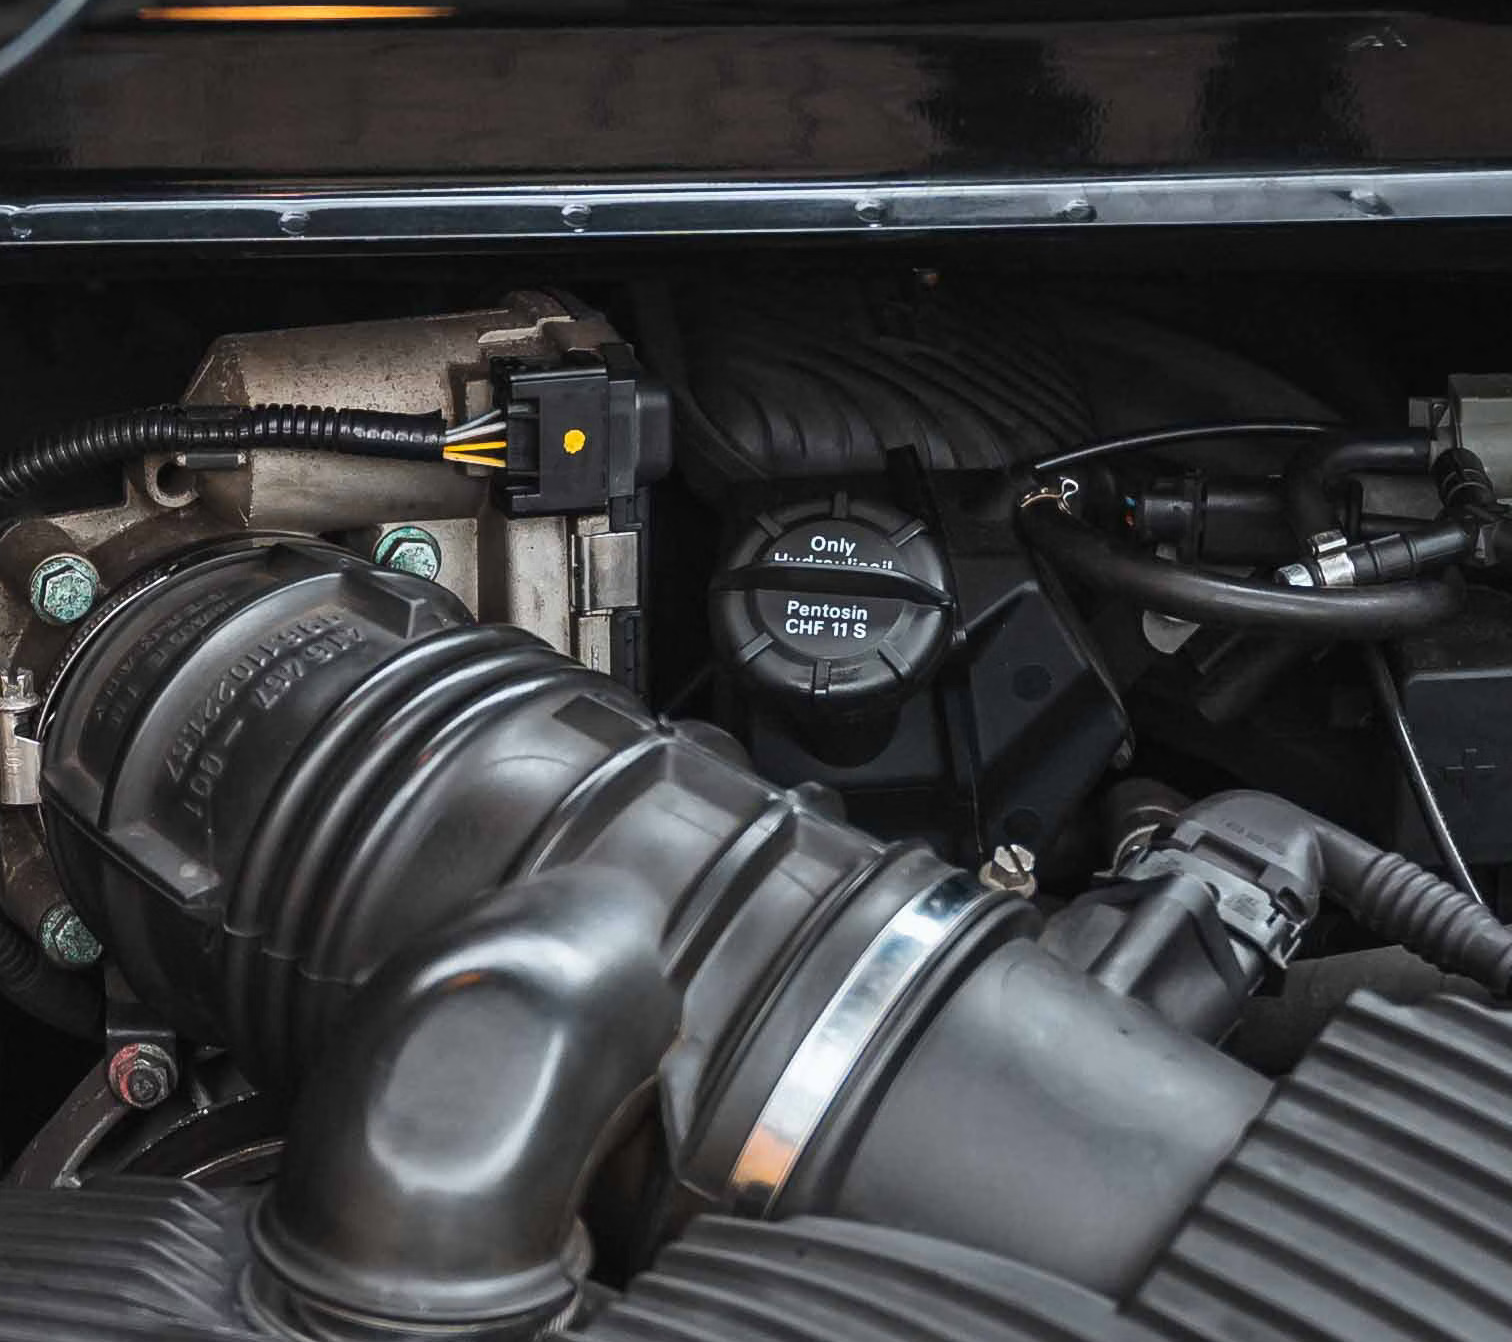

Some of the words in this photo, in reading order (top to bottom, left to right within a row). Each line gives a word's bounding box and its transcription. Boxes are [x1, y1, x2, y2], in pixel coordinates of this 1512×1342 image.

[810, 535, 856, 557] Only
[786, 600, 868, 620] Pentosin
[785, 619, 824, 636] CHF
[831, 622, 848, 637] 11
[853, 623, 867, 639] S
